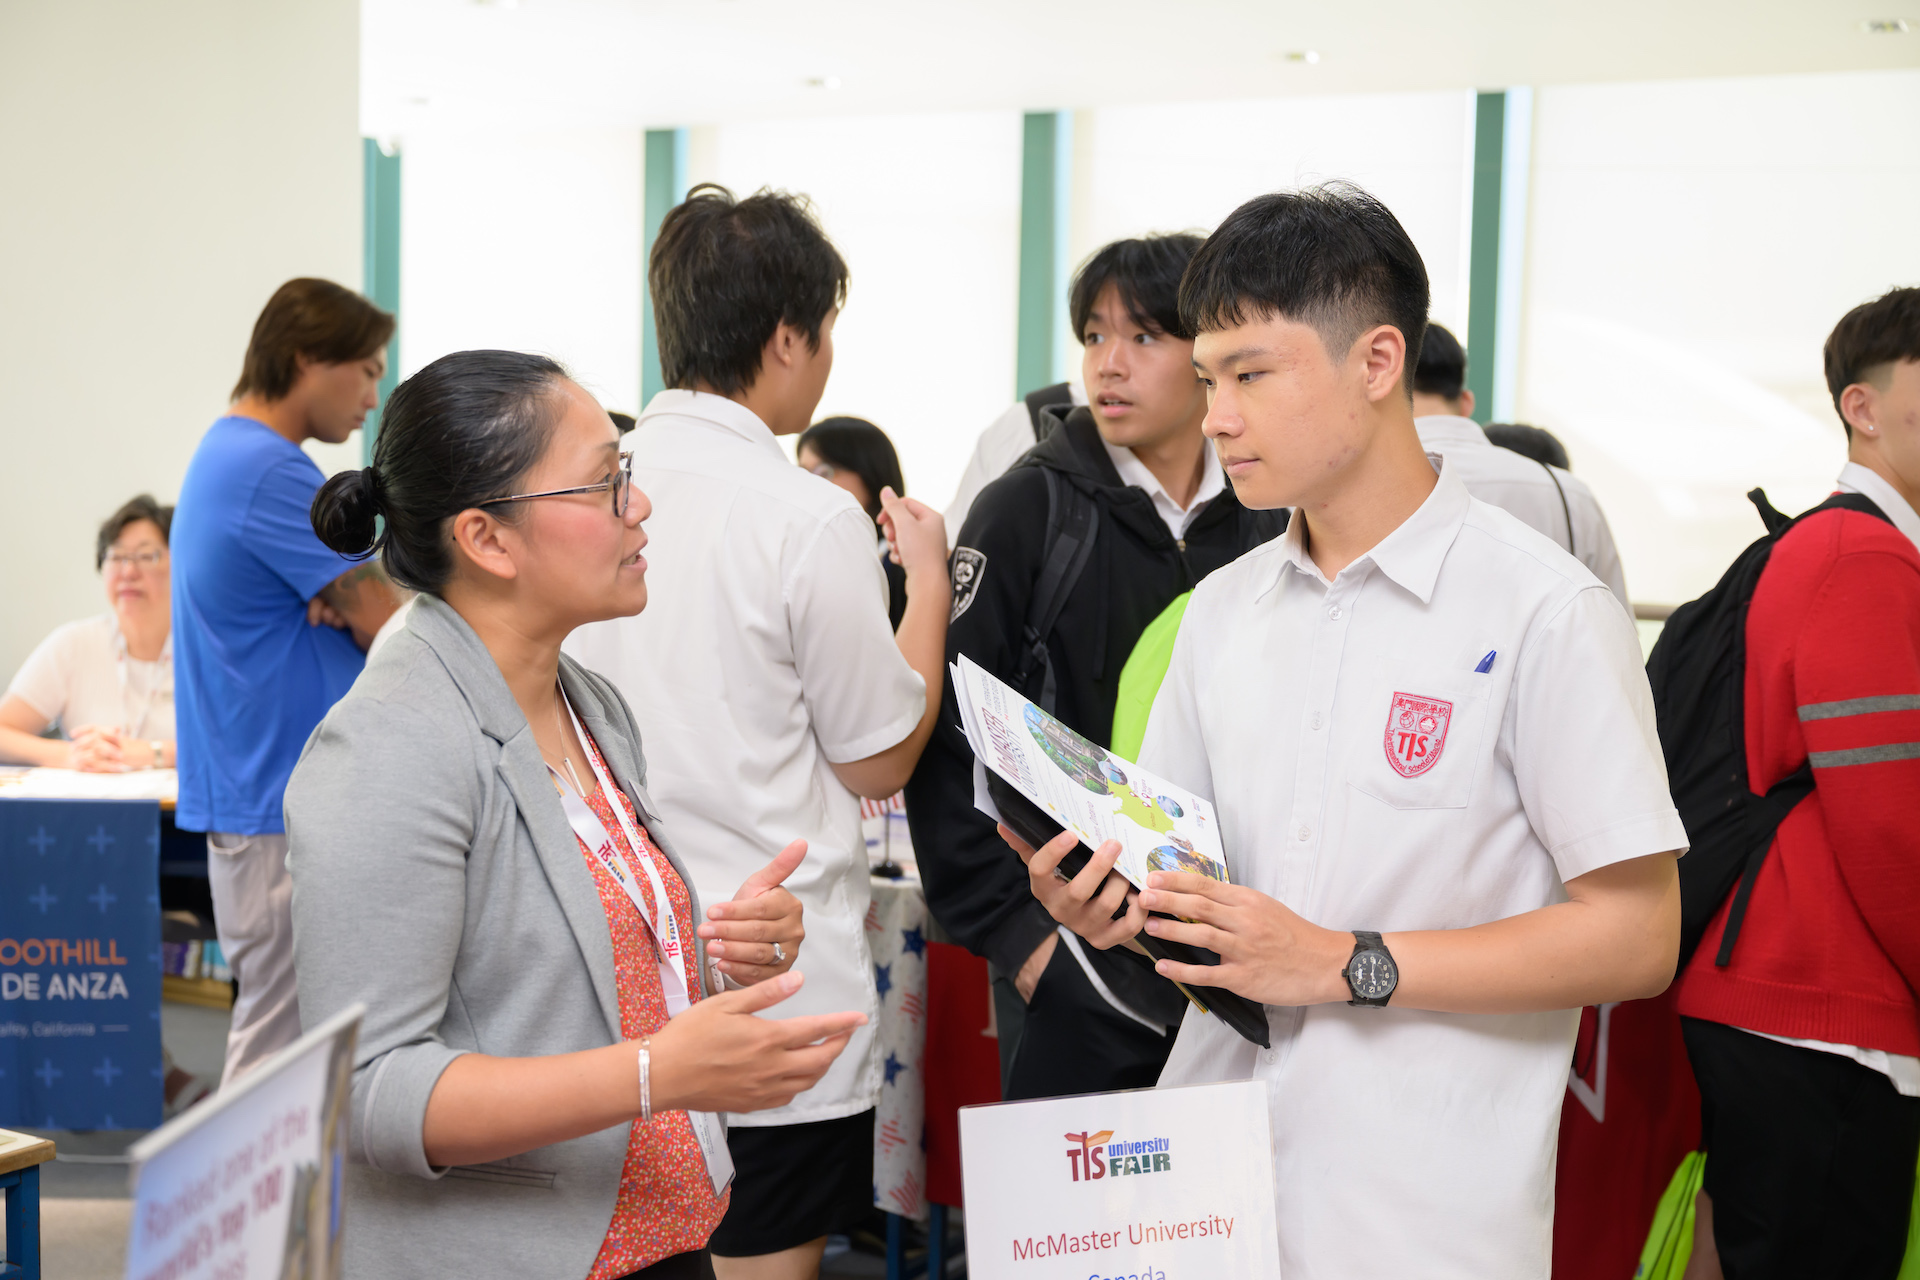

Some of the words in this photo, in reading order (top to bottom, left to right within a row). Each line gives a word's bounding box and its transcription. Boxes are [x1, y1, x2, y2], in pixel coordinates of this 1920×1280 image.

[1398, 731, 1429, 762] TIS
[598, 839, 617, 862] TIS
[661, 938, 679, 959] TIS
[1, 972, 40, 1001] DE
[46, 972, 129, 1001] ANZA
[1066, 1131, 1106, 1182] TIS
[1108, 1137, 1170, 1157] university
[1013, 1230, 1121, 1261] McMaster
[1128, 1214, 1234, 1245] University
